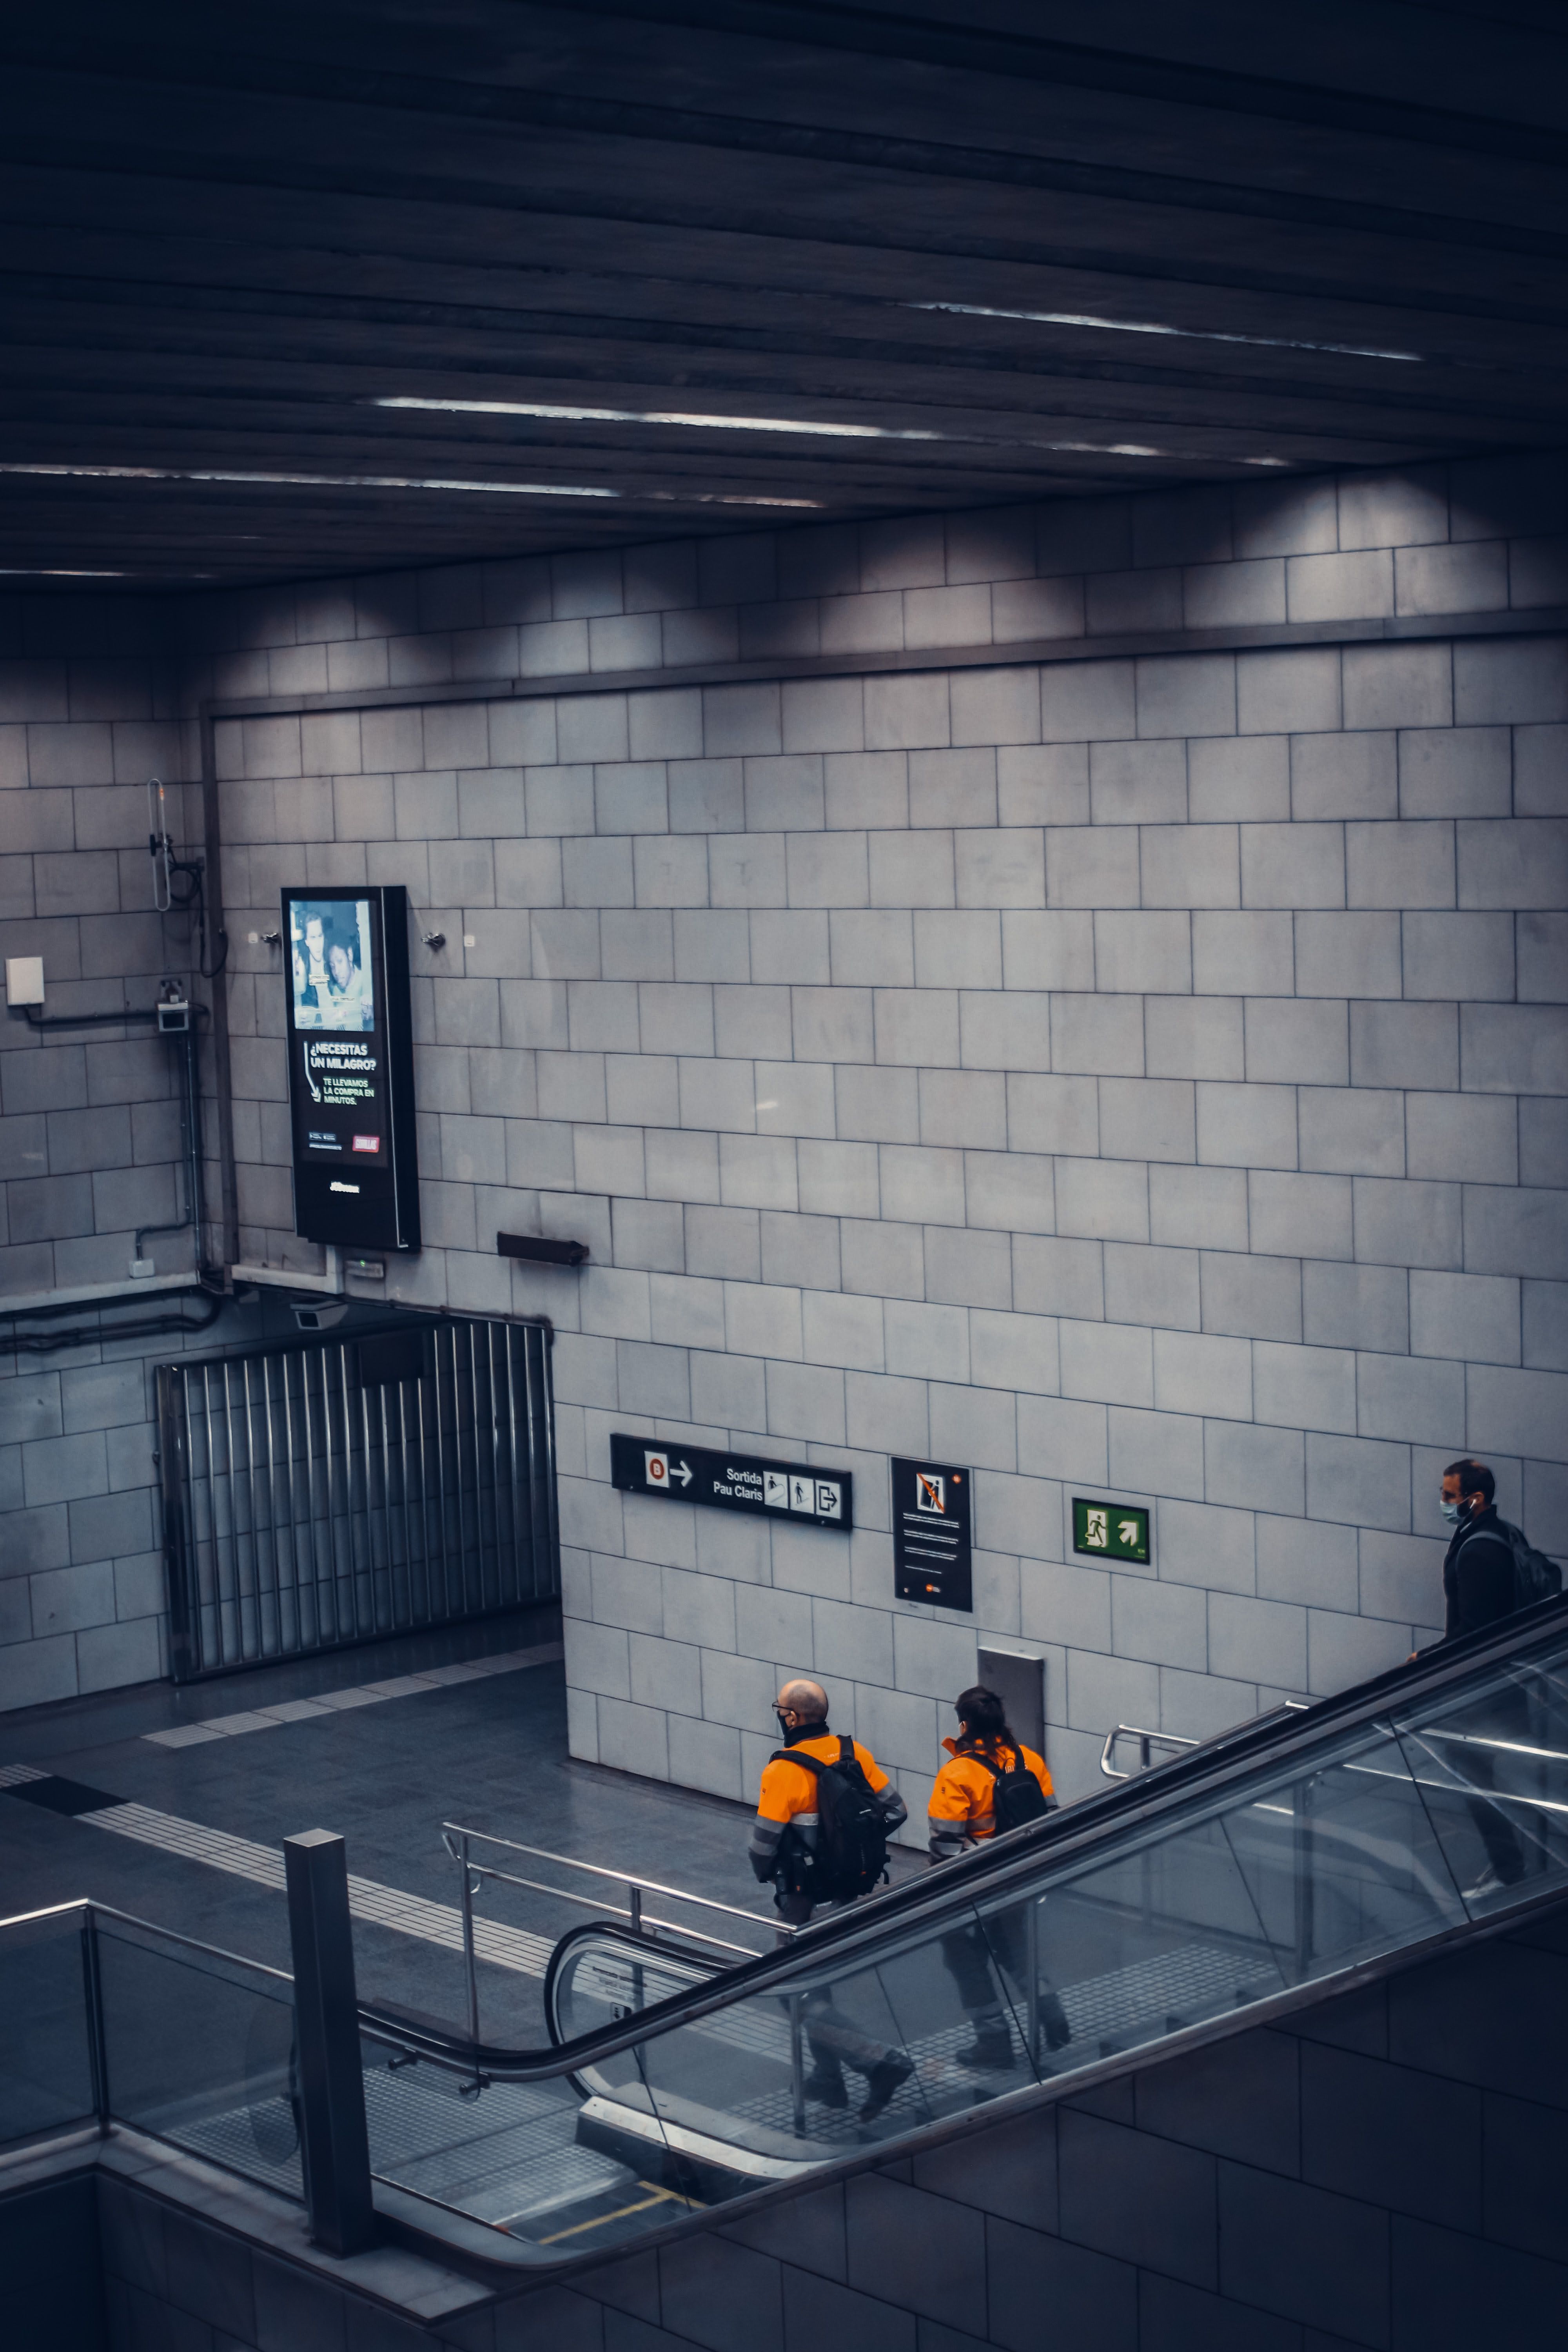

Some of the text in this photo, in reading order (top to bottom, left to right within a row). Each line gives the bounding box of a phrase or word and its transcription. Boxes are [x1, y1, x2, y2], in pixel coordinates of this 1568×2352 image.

[310, 1042, 368, 1056] ¿NECESITAS
[310, 1057, 376, 1071] UN MILAGRO?
[332, 1078, 368, 1087] LLEVAMOS
[334, 1087, 364, 1096] COMPRA
[324, 1096, 357, 1105] MINUTOS.
[726, 1468, 762, 1485] Sortida
[713, 1481, 763, 1501] Pau Claris
